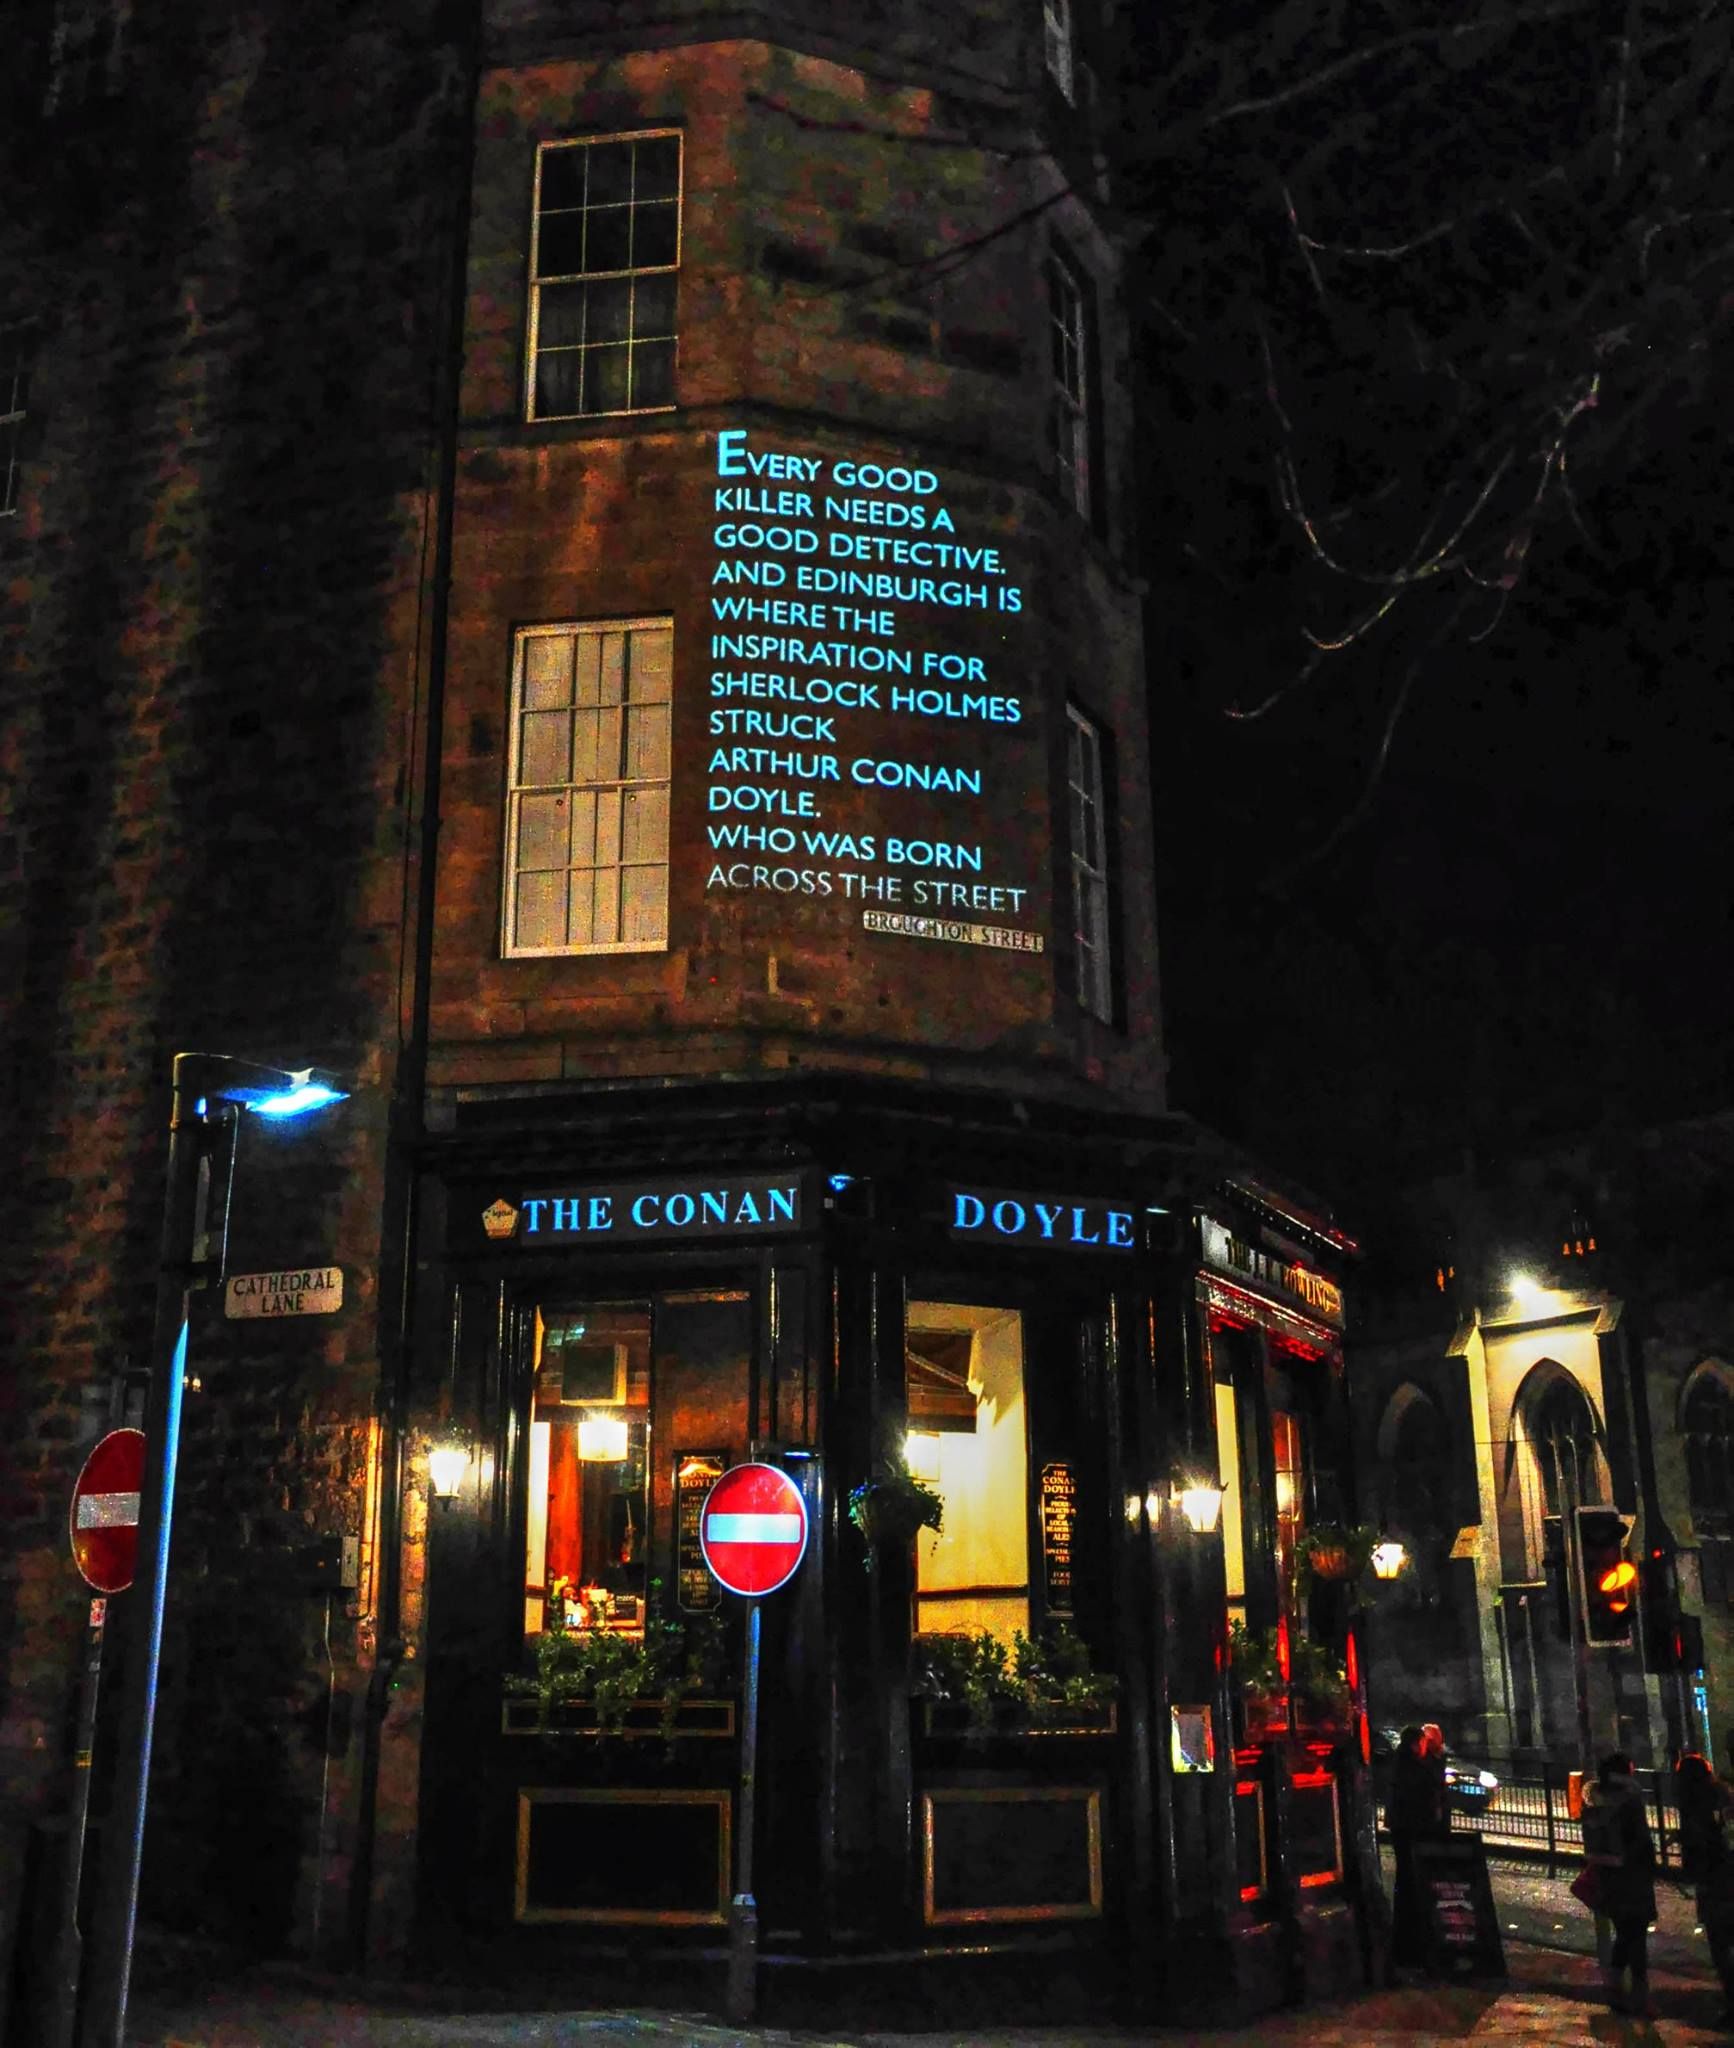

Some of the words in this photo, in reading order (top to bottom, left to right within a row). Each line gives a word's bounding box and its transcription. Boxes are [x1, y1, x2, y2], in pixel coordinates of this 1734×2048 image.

[718, 430, 822, 481] EVERY
[833, 462, 938, 494] GOOD
[715, 488, 814, 518] KILLER
[825, 497, 926, 530] NEEDS
[931, 508, 955, 532] A
[714, 524, 819, 554] GOOD
[830, 533, 1006, 574] DETECTIVE.
[712, 560, 786, 587] AND
[797, 566, 987, 608] EDINBURGH
[999, 586, 1022, 612] IS
[712, 597, 826, 629] WHERE
[832, 605, 895, 636] THE
[711, 634, 912, 674] INSPIRATION
[923, 653, 987, 682] FOR
[710, 672, 880, 709] SHERLOCK
[892, 687, 1021, 723] HOLMES
[710, 710, 836, 742] STRUCK
[708, 748, 840, 781] ARTHUR
[851, 759, 981, 794] CONAN
[708, 786, 821, 818] DOYLE.
[707, 825, 796, 853] WHO
[802, 830, 875, 860] WAS
[886, 838, 982, 872] BORN
[706, 864, 832, 896] ACROSS
[838, 872, 902, 902] THE
[913, 880, 1027, 913] STREET
[867, 912, 973, 941] BROUGHTON
[982, 927, 1039, 950] STREET
[522, 1197, 613, 1232] THE
[632, 1188, 797, 1226] CONAN
[953, 1194, 1135, 1247] DOYLE
[233, 1271, 336, 1296] CATHEDRAL
[262, 1293, 305, 1313] LANE
[1042, 1476, 1077, 1485] CONA
